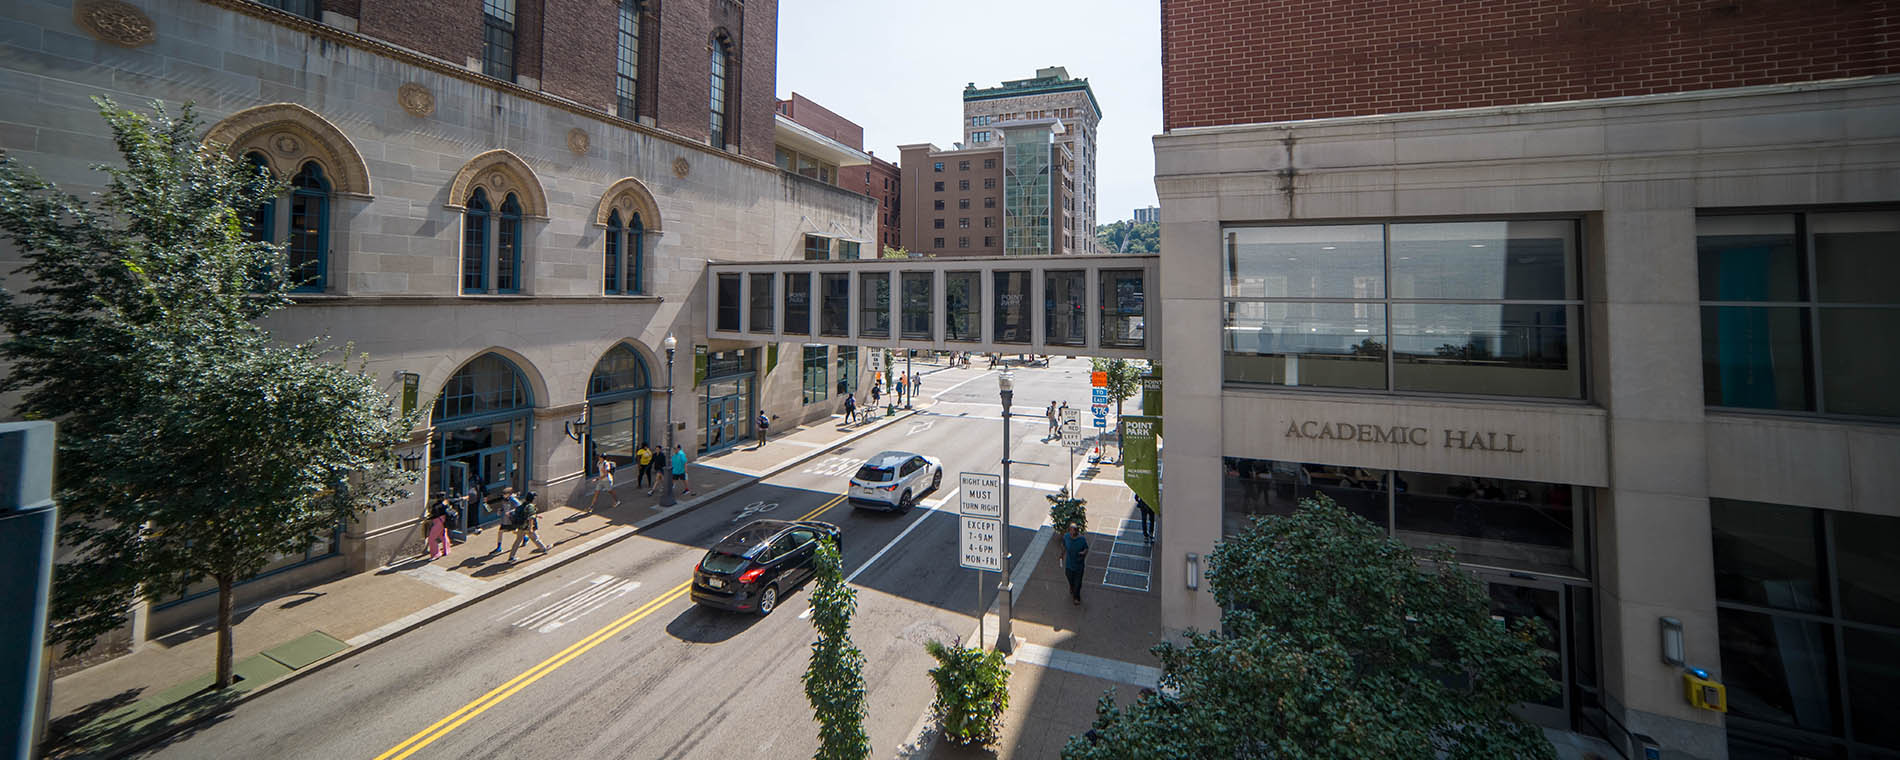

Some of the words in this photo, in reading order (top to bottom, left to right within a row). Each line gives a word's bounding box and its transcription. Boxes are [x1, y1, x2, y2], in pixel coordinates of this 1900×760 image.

[1093, 407, 1107, 416] 376
[1126, 421, 1153, 429] POINT
[1285, 418, 1427, 447] ACADEMIC
[1444, 429, 1524, 453] HALL
[962, 477, 980, 486] RIGHT
[981, 479, 998, 487] LANE
[969, 490, 991, 500] MUST
[962, 502, 979, 510] TURN
[980, 503, 998, 512] RIGHT
[967, 520, 995, 531] EXCEPT
[965, 554, 998, 566] MON-FRI
